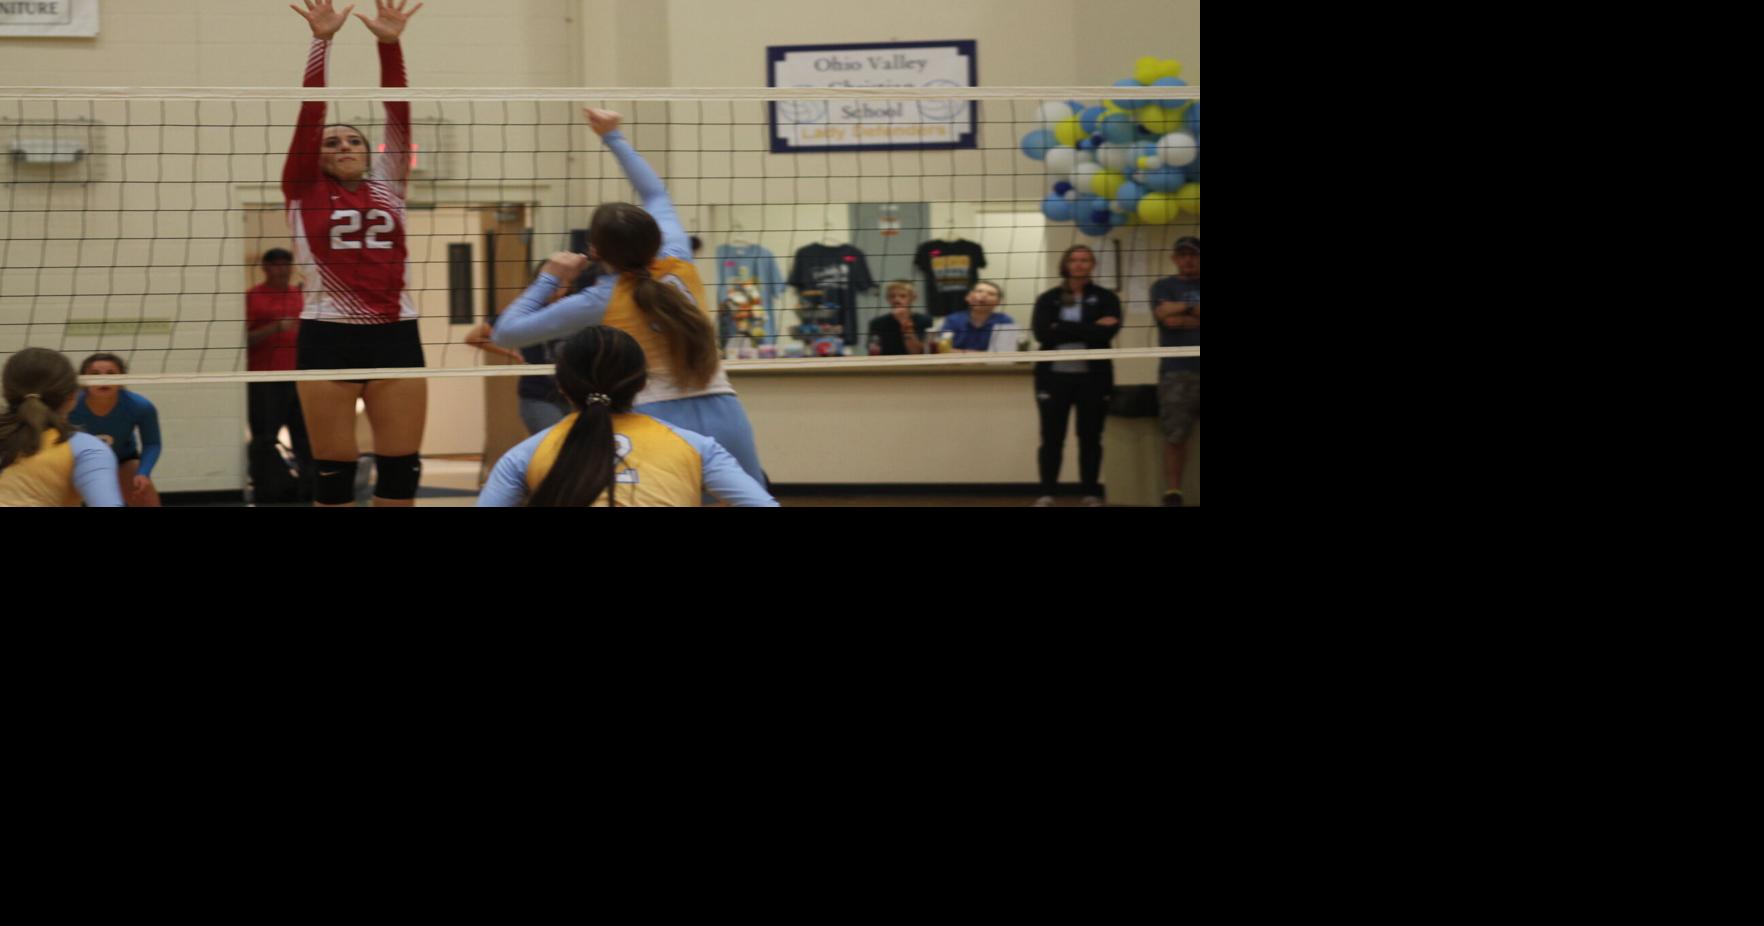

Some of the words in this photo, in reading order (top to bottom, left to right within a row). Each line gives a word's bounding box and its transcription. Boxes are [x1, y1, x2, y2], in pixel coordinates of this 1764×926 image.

[813, 55, 863, 72] Ohio
[866, 53, 928, 75] Valley
[841, 101, 904, 119] School
[802, 127, 845, 140] Lady
[329, 208, 396, 250] 22
